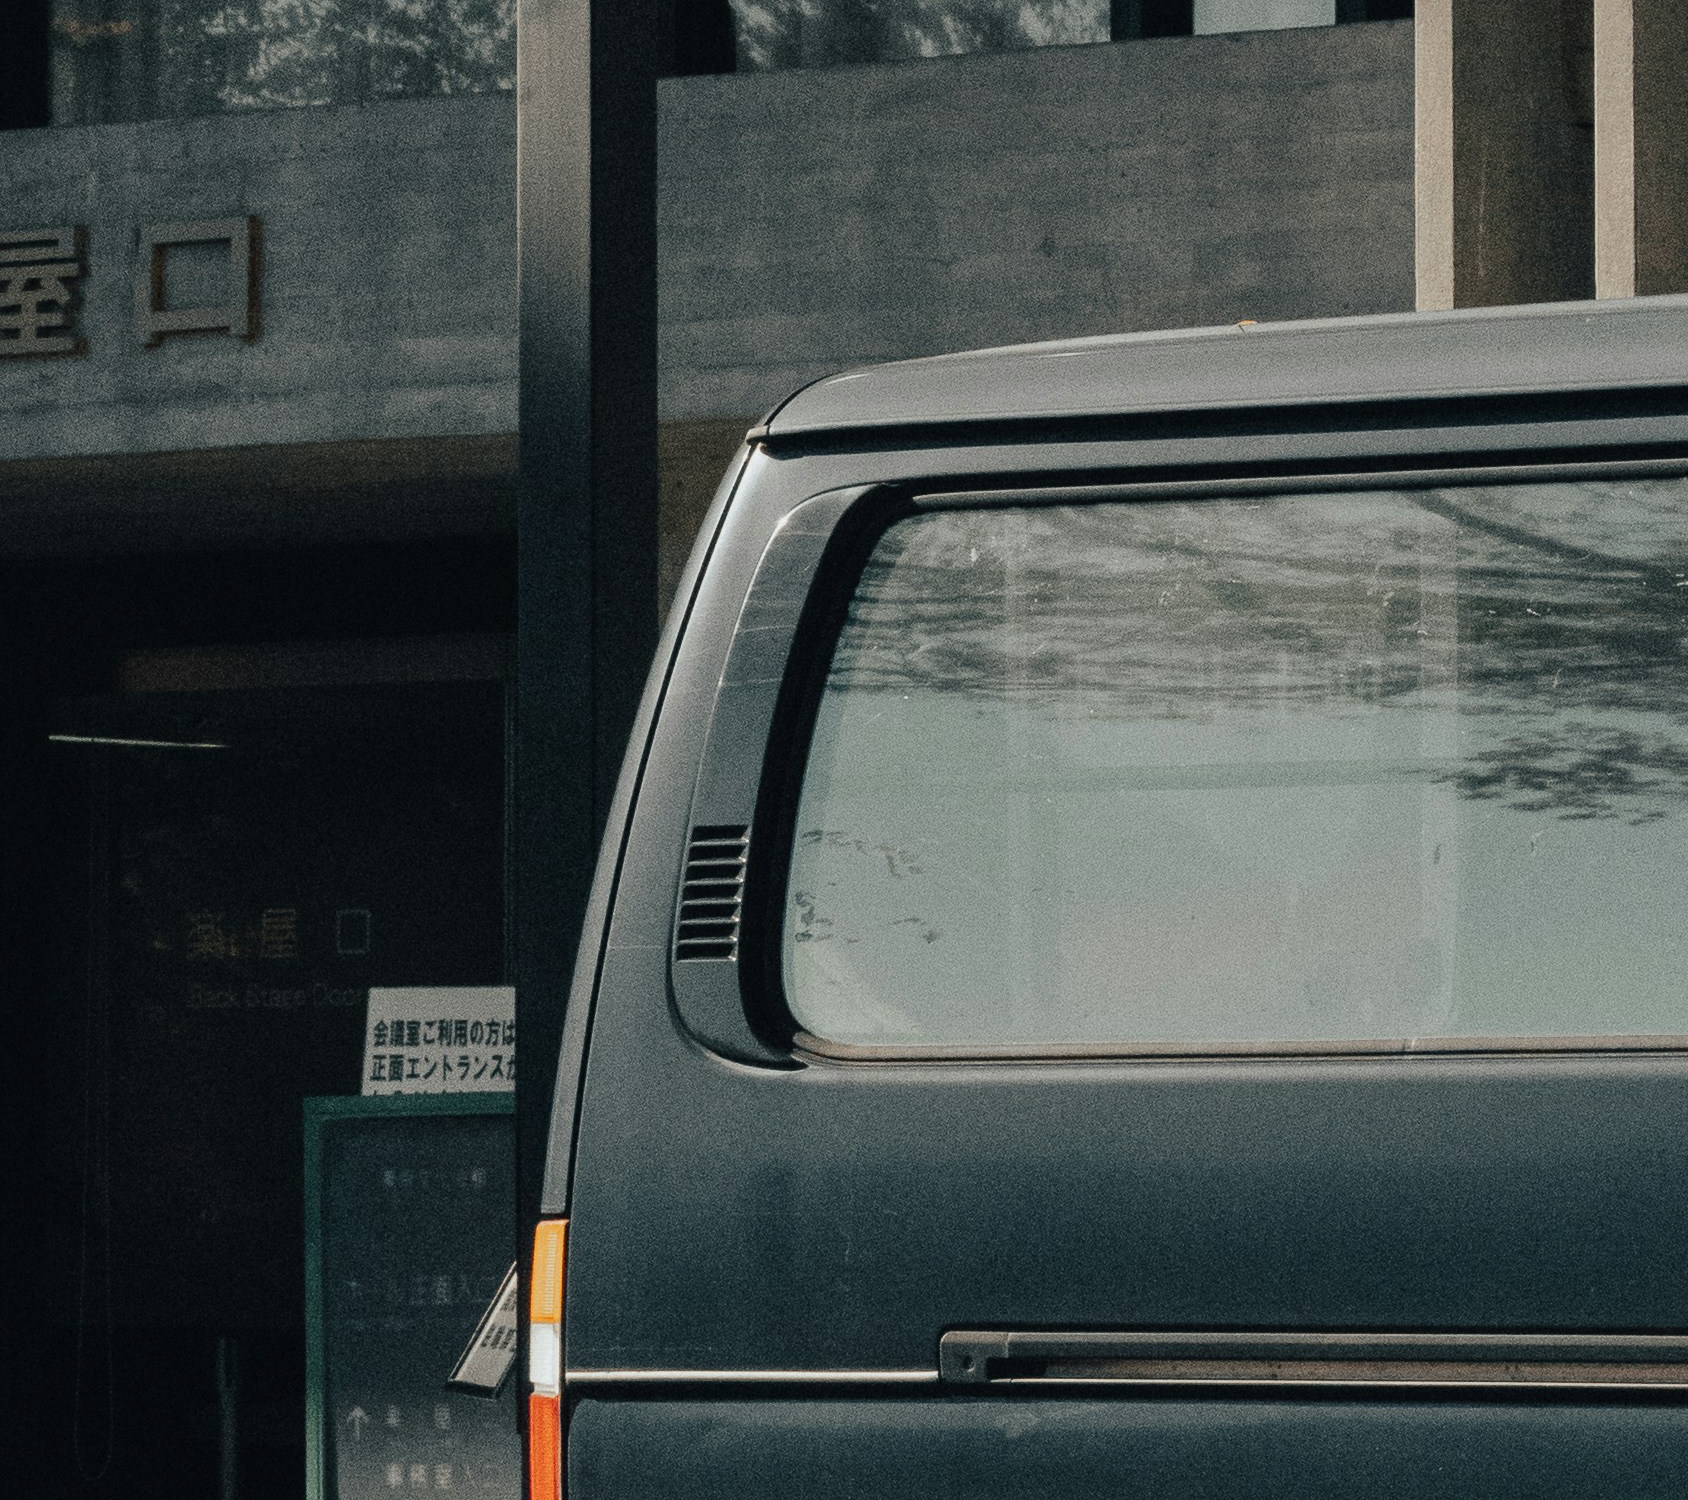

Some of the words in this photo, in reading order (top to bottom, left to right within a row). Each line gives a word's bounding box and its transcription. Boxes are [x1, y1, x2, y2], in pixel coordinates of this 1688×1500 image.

[373, 1019, 516, 1048] 会議室ご利用の方は
